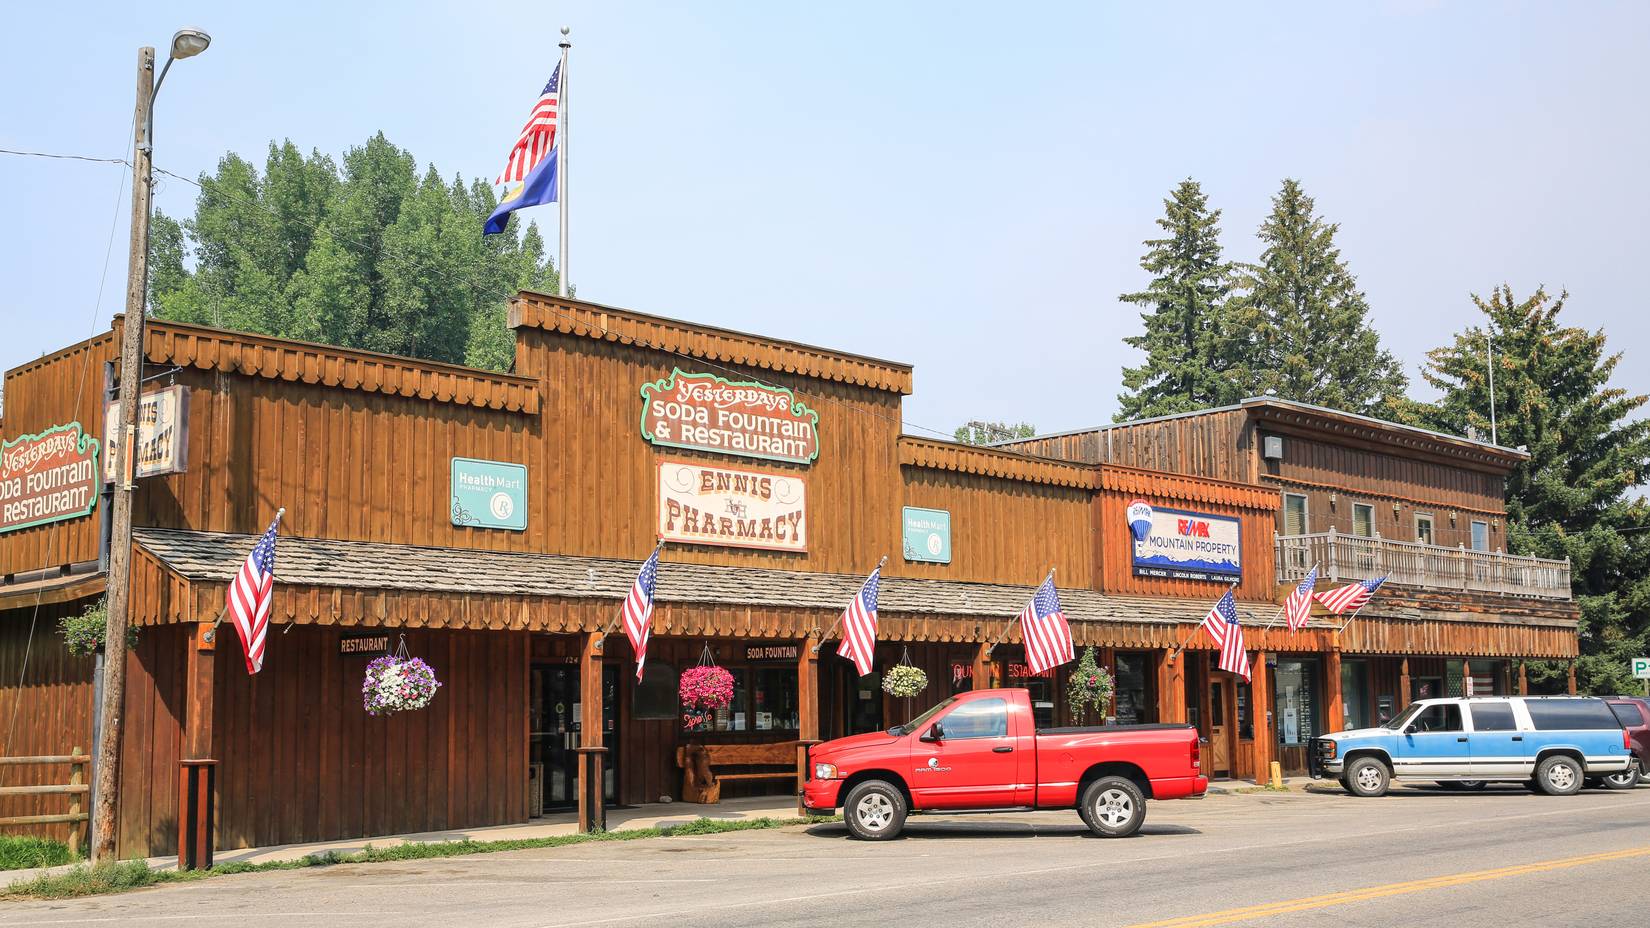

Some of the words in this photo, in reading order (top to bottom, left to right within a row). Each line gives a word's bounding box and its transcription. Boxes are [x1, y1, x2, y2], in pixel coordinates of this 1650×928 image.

[655, 421, 670, 439] &
[460, 472, 495, 486] Health
[496, 477, 519, 488] Mart
[700, 470, 772, 500] ENNIS
[667, 497, 802, 541] PHARMACY
[1149, 536, 1193, 551] MOUNTAIN
[1196, 541, 1236, 554] PROPERTY
[341, 637, 388, 652] RESTAURANT
[747, 648, 763, 659] SODA
[765, 647, 797, 658] FOUNTAIN
